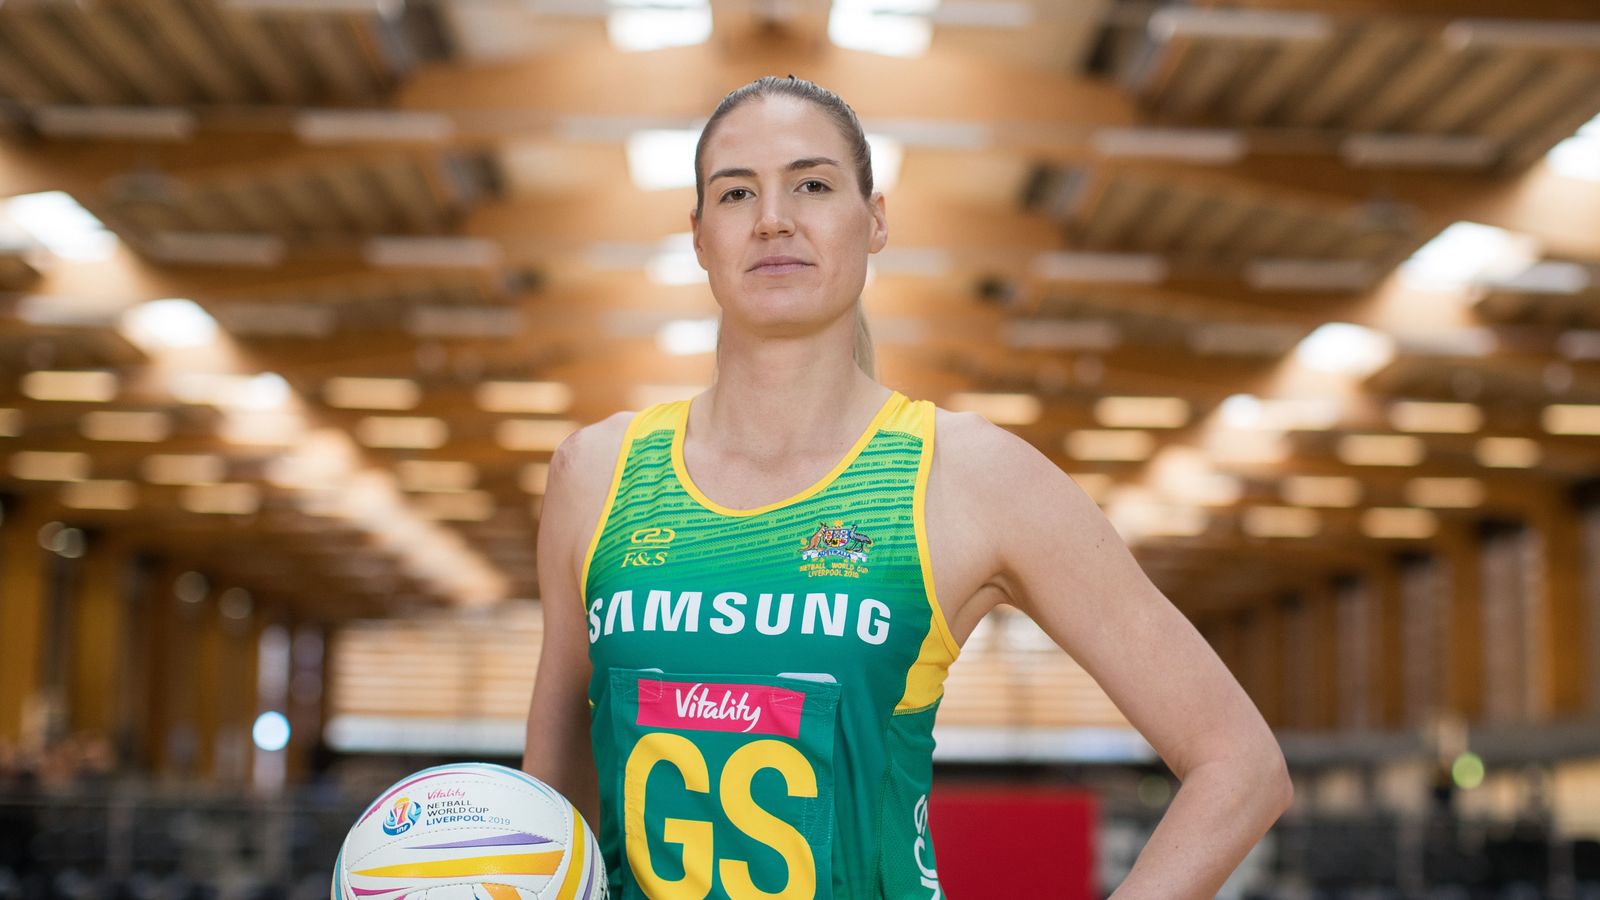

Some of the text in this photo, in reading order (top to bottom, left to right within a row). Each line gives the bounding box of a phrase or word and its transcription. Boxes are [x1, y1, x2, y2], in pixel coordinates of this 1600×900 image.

[620, 551, 669, 568] F&S
[799, 562, 869, 574] NETBALL WORLD CUP
[808, 569, 842, 577] LIVERPOOL
[588, 590, 892, 646] SAMSUNG
[675, 682, 762, 733] Vitality
[427, 788, 466, 800] Vitality
[426, 800, 473, 810] NETBALL
[427, 806, 490, 817] WORLD CUP
[624, 732, 818, 900] GS
[426, 815, 511, 826] LIVERPOOL 2019
